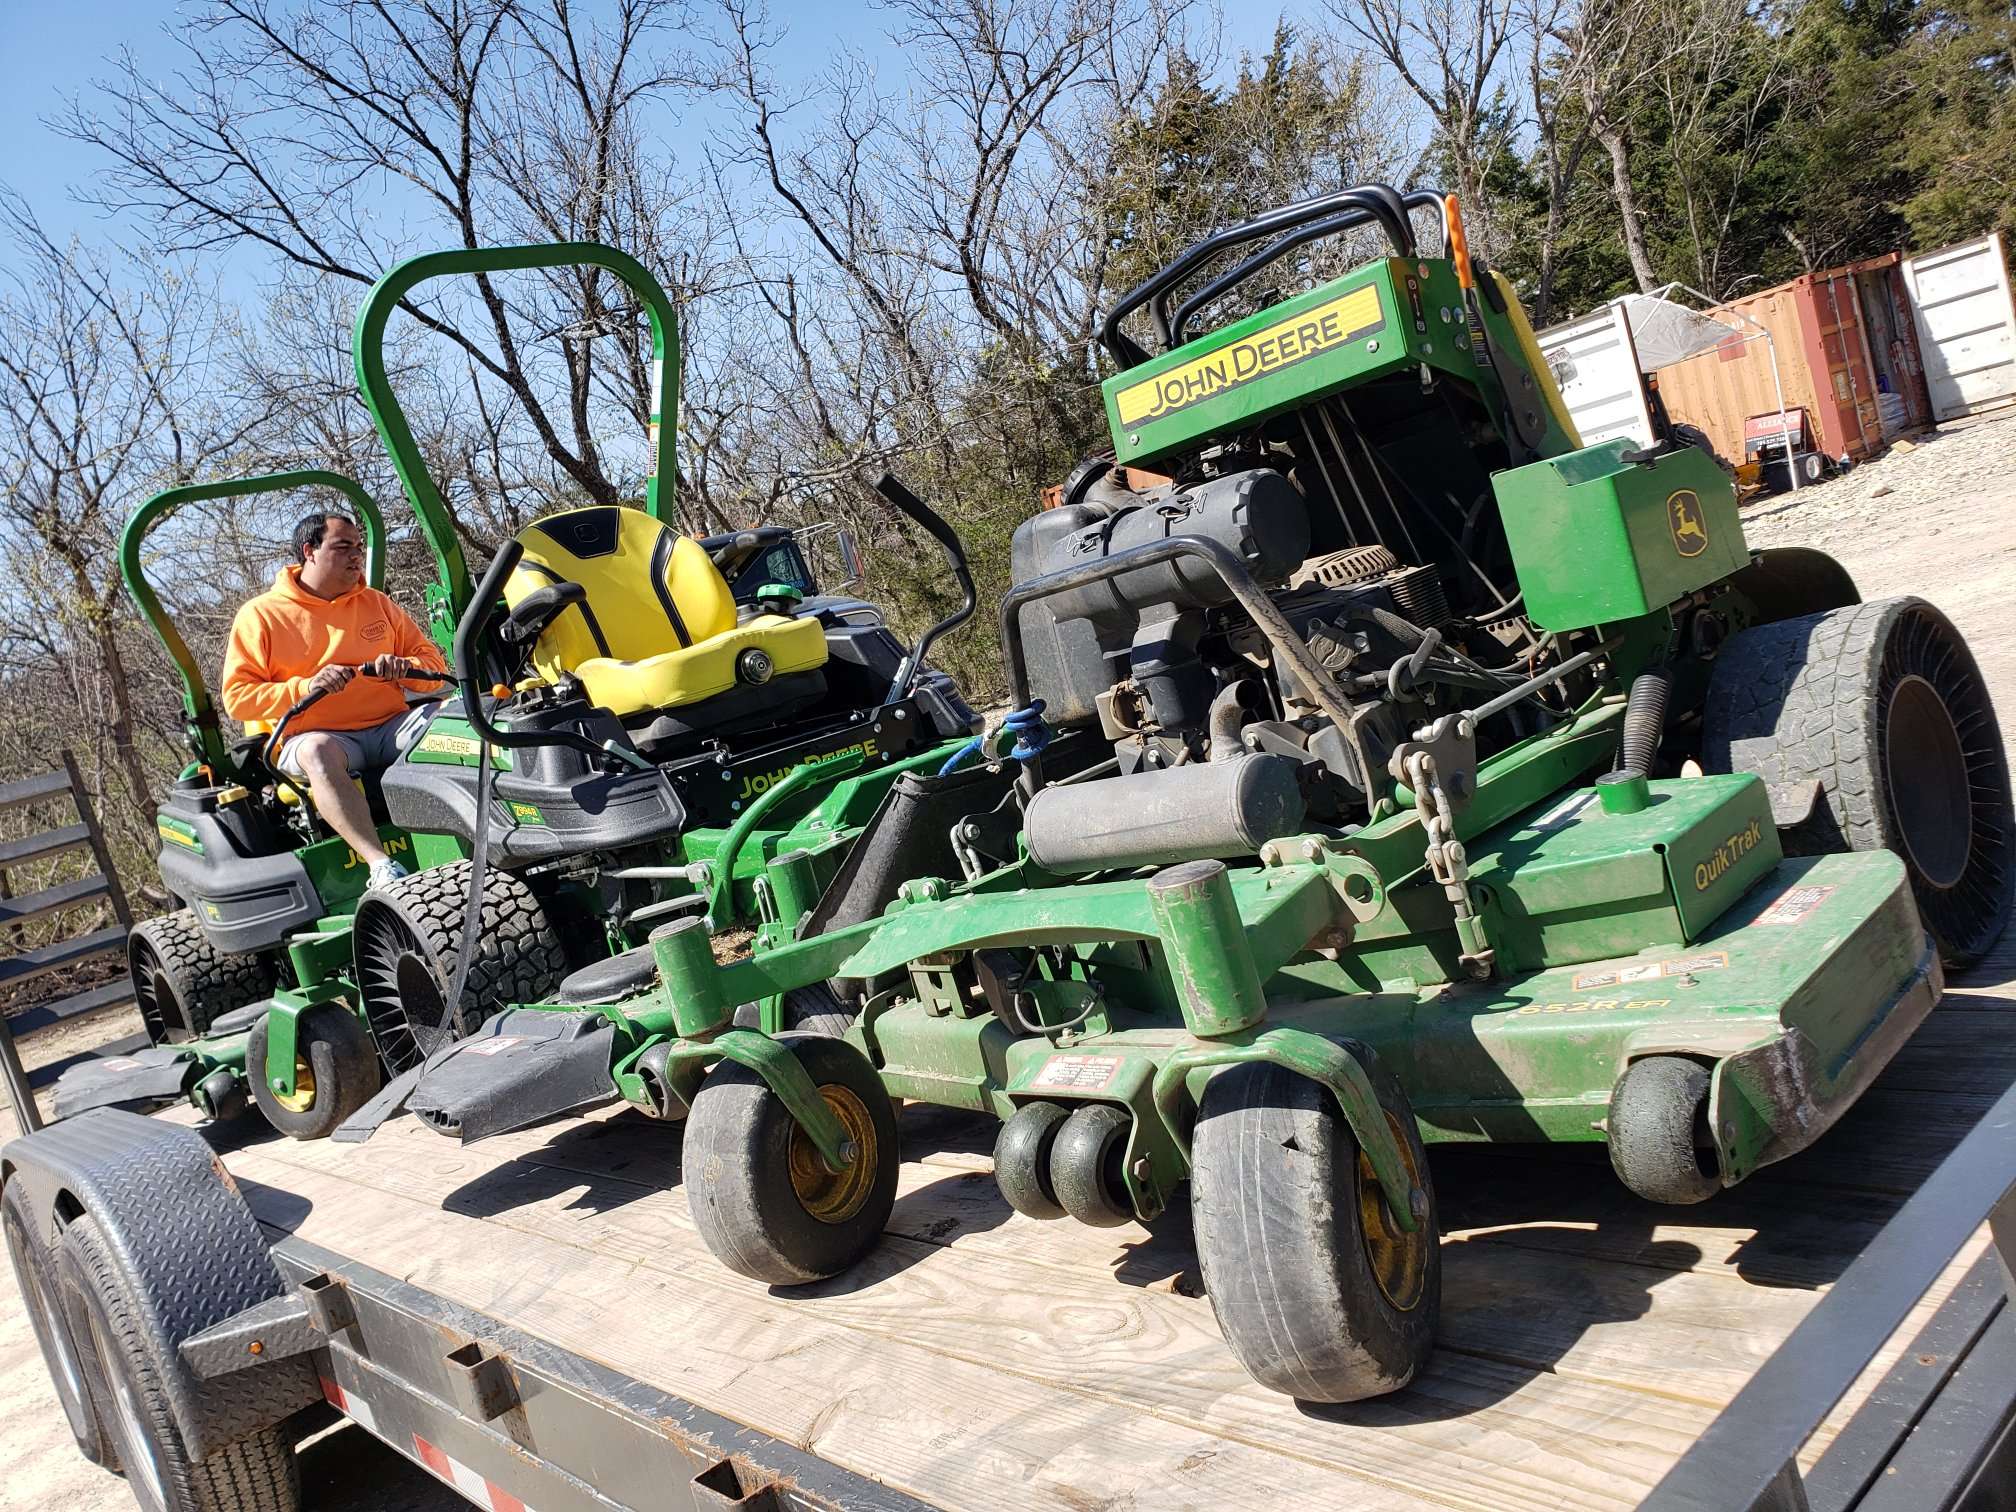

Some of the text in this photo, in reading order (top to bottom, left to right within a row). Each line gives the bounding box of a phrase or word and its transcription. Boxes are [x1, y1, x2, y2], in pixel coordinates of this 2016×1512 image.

[1150, 312, 1343, 412] JOHN DEERE
[426, 738, 470, 753] JOHN DEERE
[1695, 821, 1762, 891] Quik Trak
[1518, 999, 1672, 1015] 652R EFI
